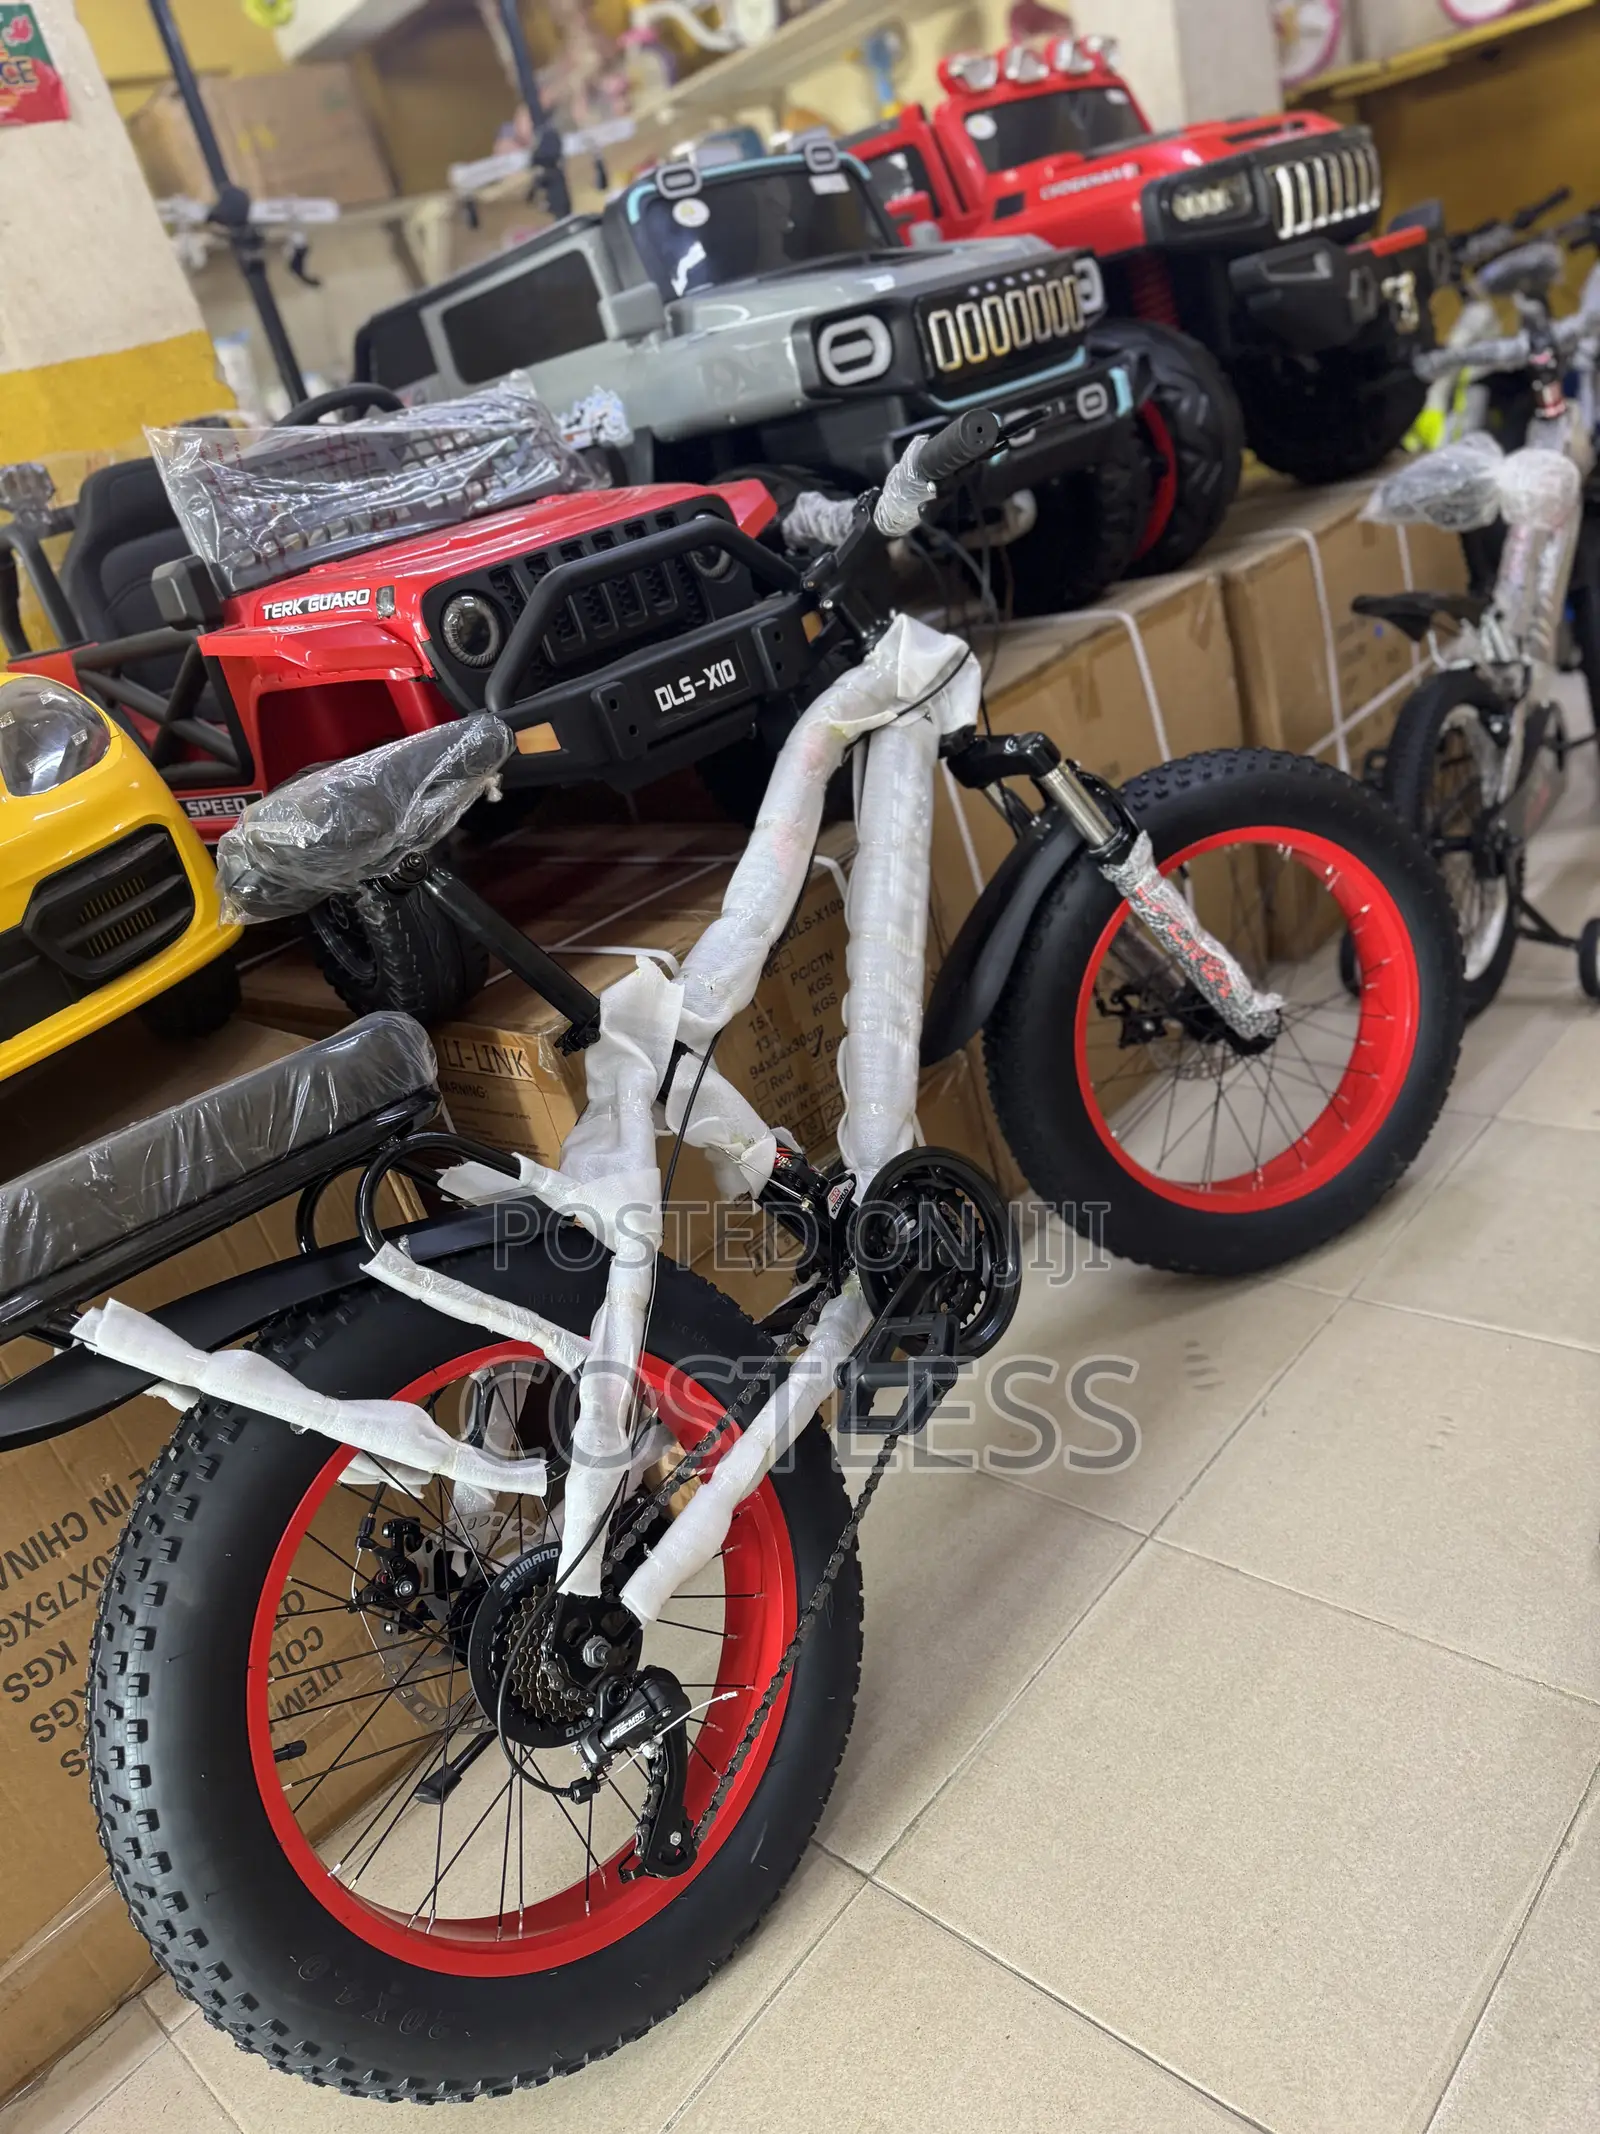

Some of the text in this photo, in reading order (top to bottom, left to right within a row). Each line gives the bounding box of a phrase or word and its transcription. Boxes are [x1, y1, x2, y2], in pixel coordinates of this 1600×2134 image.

[262, 597, 305, 620] TERK
[654, 658, 737, 712] DLS-X10
[186, 797, 247, 816] SPEED
[790, 948, 835, 987] PC/CTN
[807, 972, 834, 997] KGS
[812, 992, 839, 1017] KGS
[769, 1064, 794, 1091] Red
[89, 1484, 131, 1526] IN
[500, 1547, 559, 1592] SHIMANO
[3, 1640, 78, 1703] KGS
